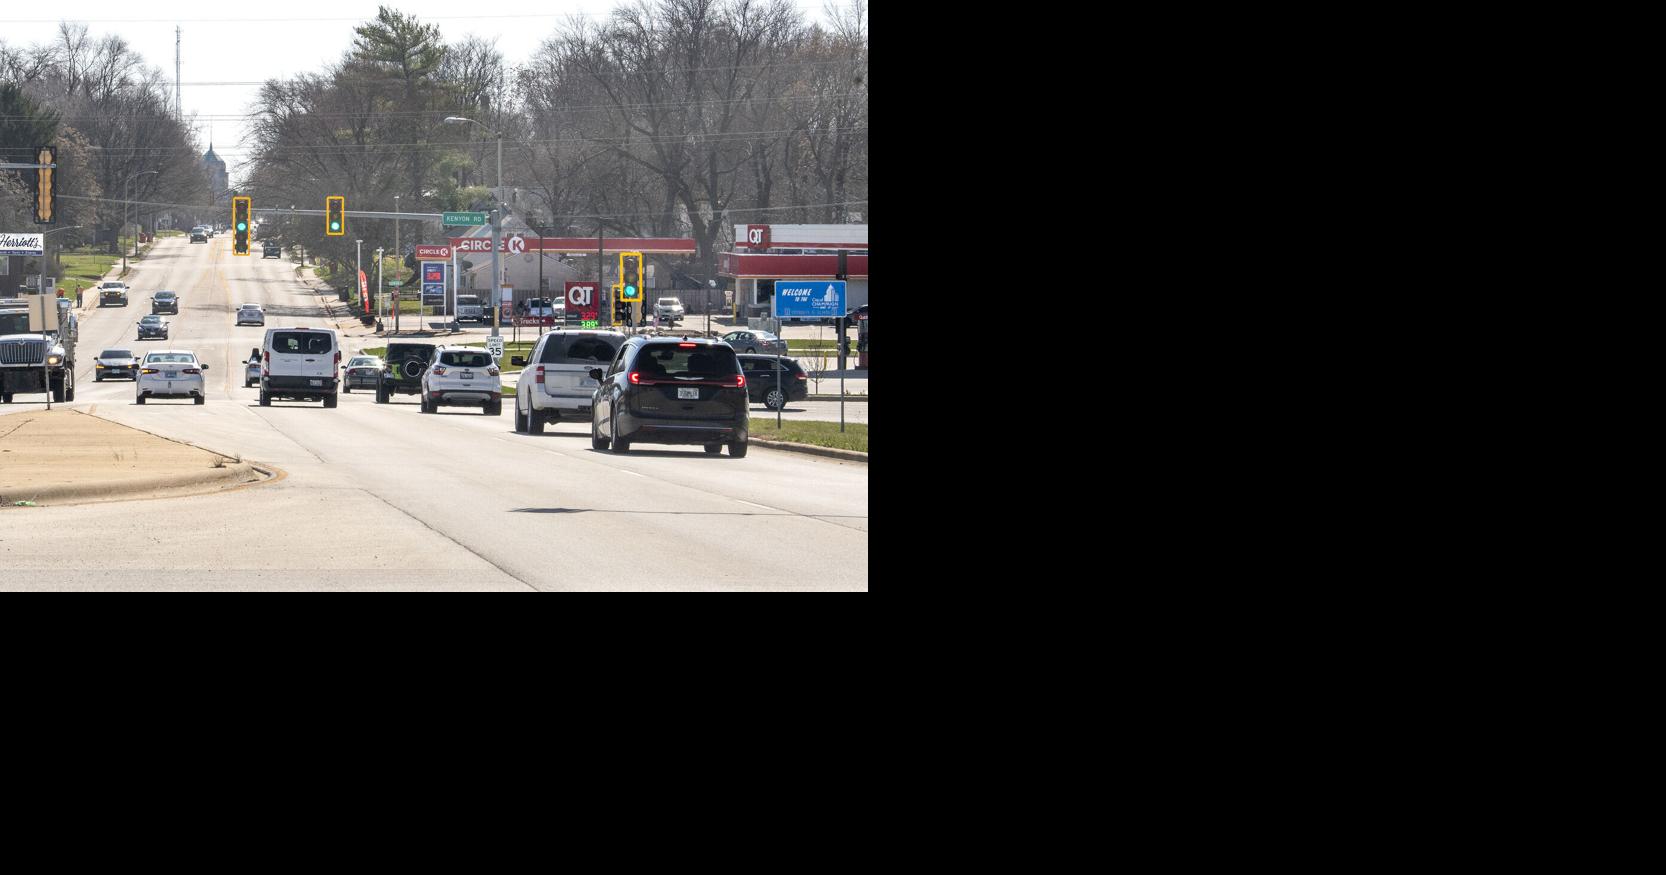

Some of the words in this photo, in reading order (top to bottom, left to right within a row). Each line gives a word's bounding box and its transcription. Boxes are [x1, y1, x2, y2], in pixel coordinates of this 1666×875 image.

[748, 228, 763, 244] QT
[460, 240, 505, 251] CIRCE
[568, 286, 594, 306] QT
[782, 288, 812, 297] WELCOME
[489, 347, 501, 356] 35
